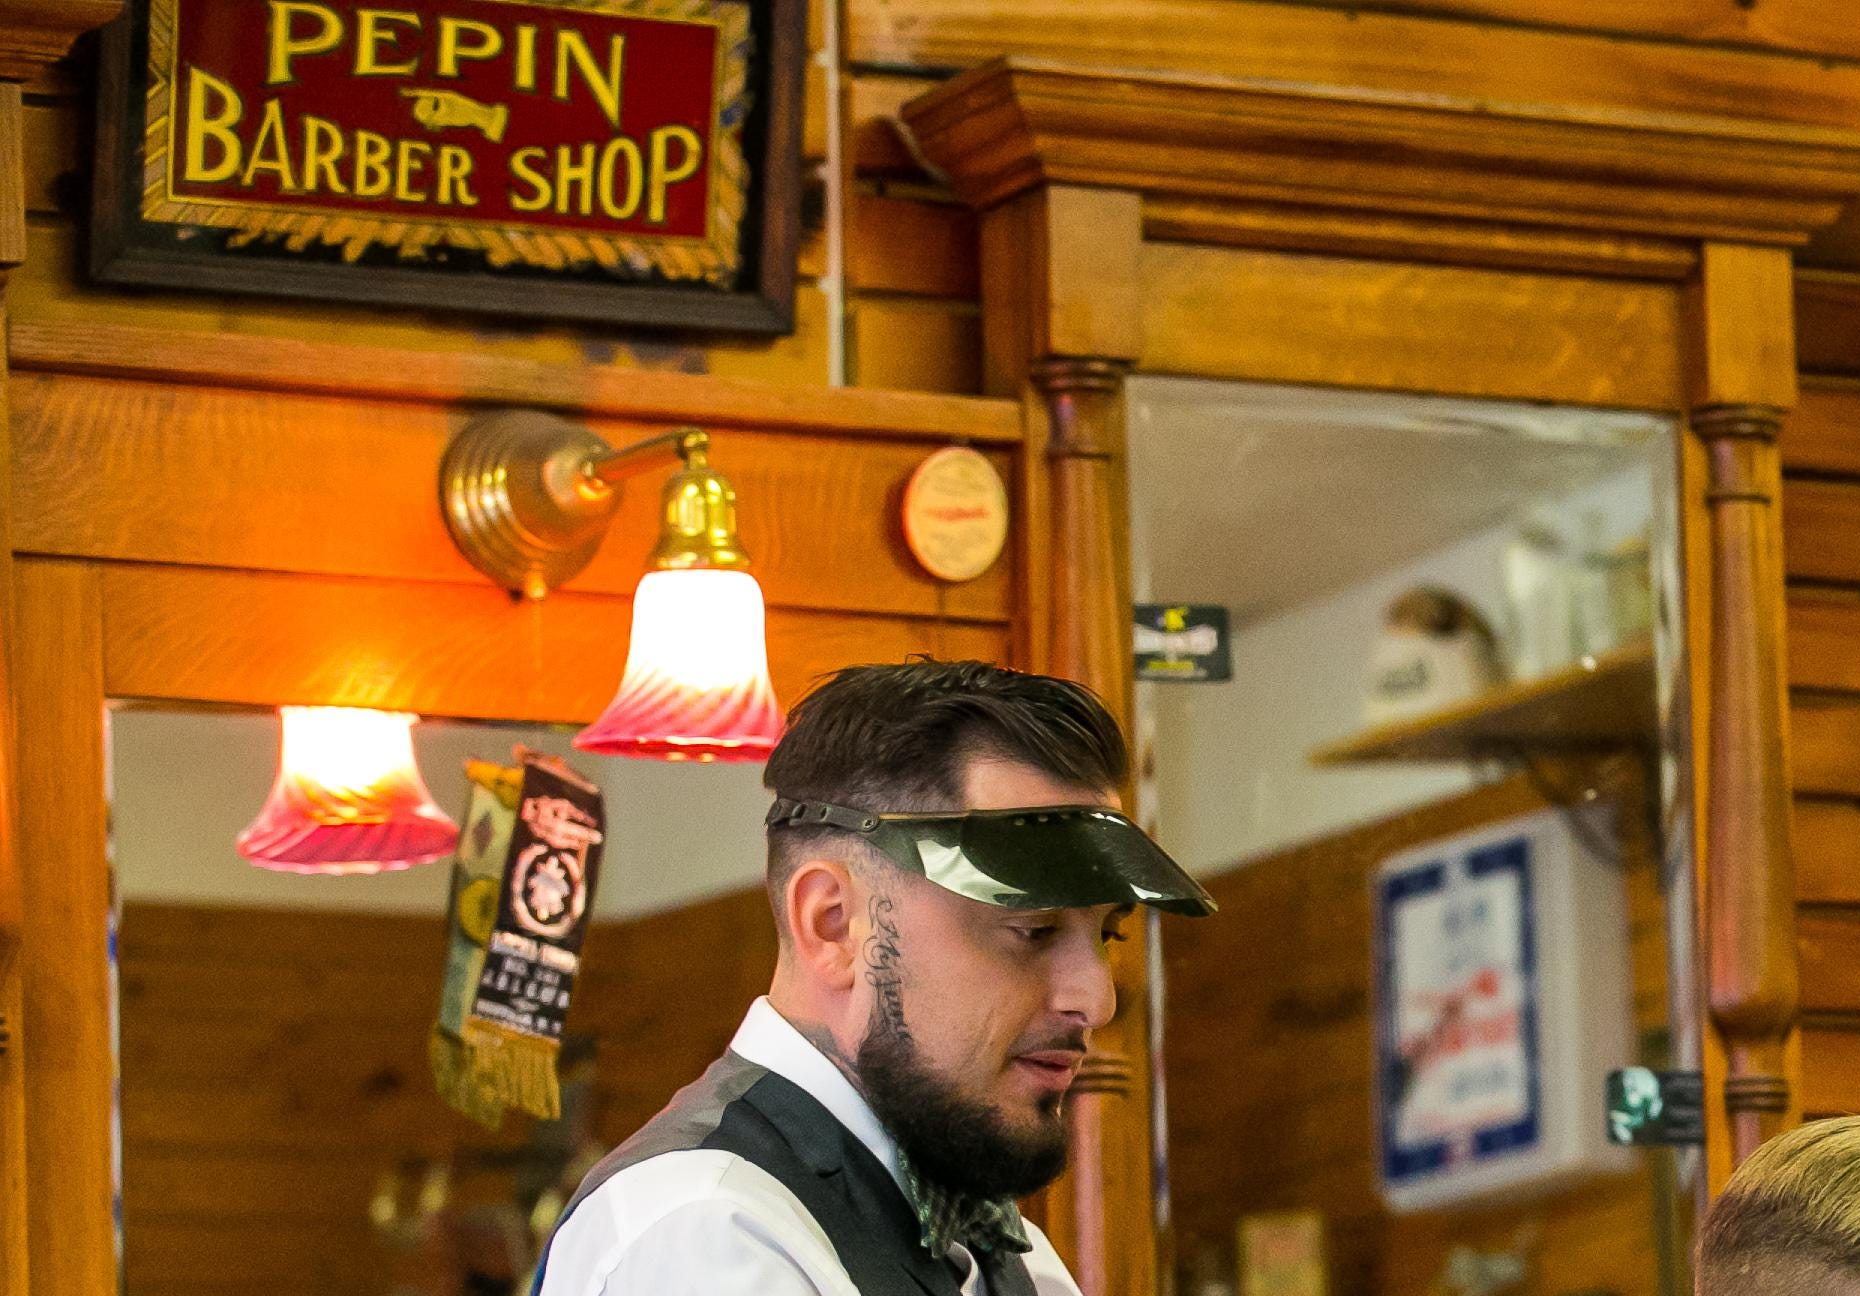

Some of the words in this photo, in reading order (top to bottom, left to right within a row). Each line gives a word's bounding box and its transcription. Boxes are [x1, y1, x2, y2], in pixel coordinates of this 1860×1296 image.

[265, 0, 625, 126] PEPIN
[184, 66, 477, 205] BARBER
[509, 125, 701, 223] SHOP
